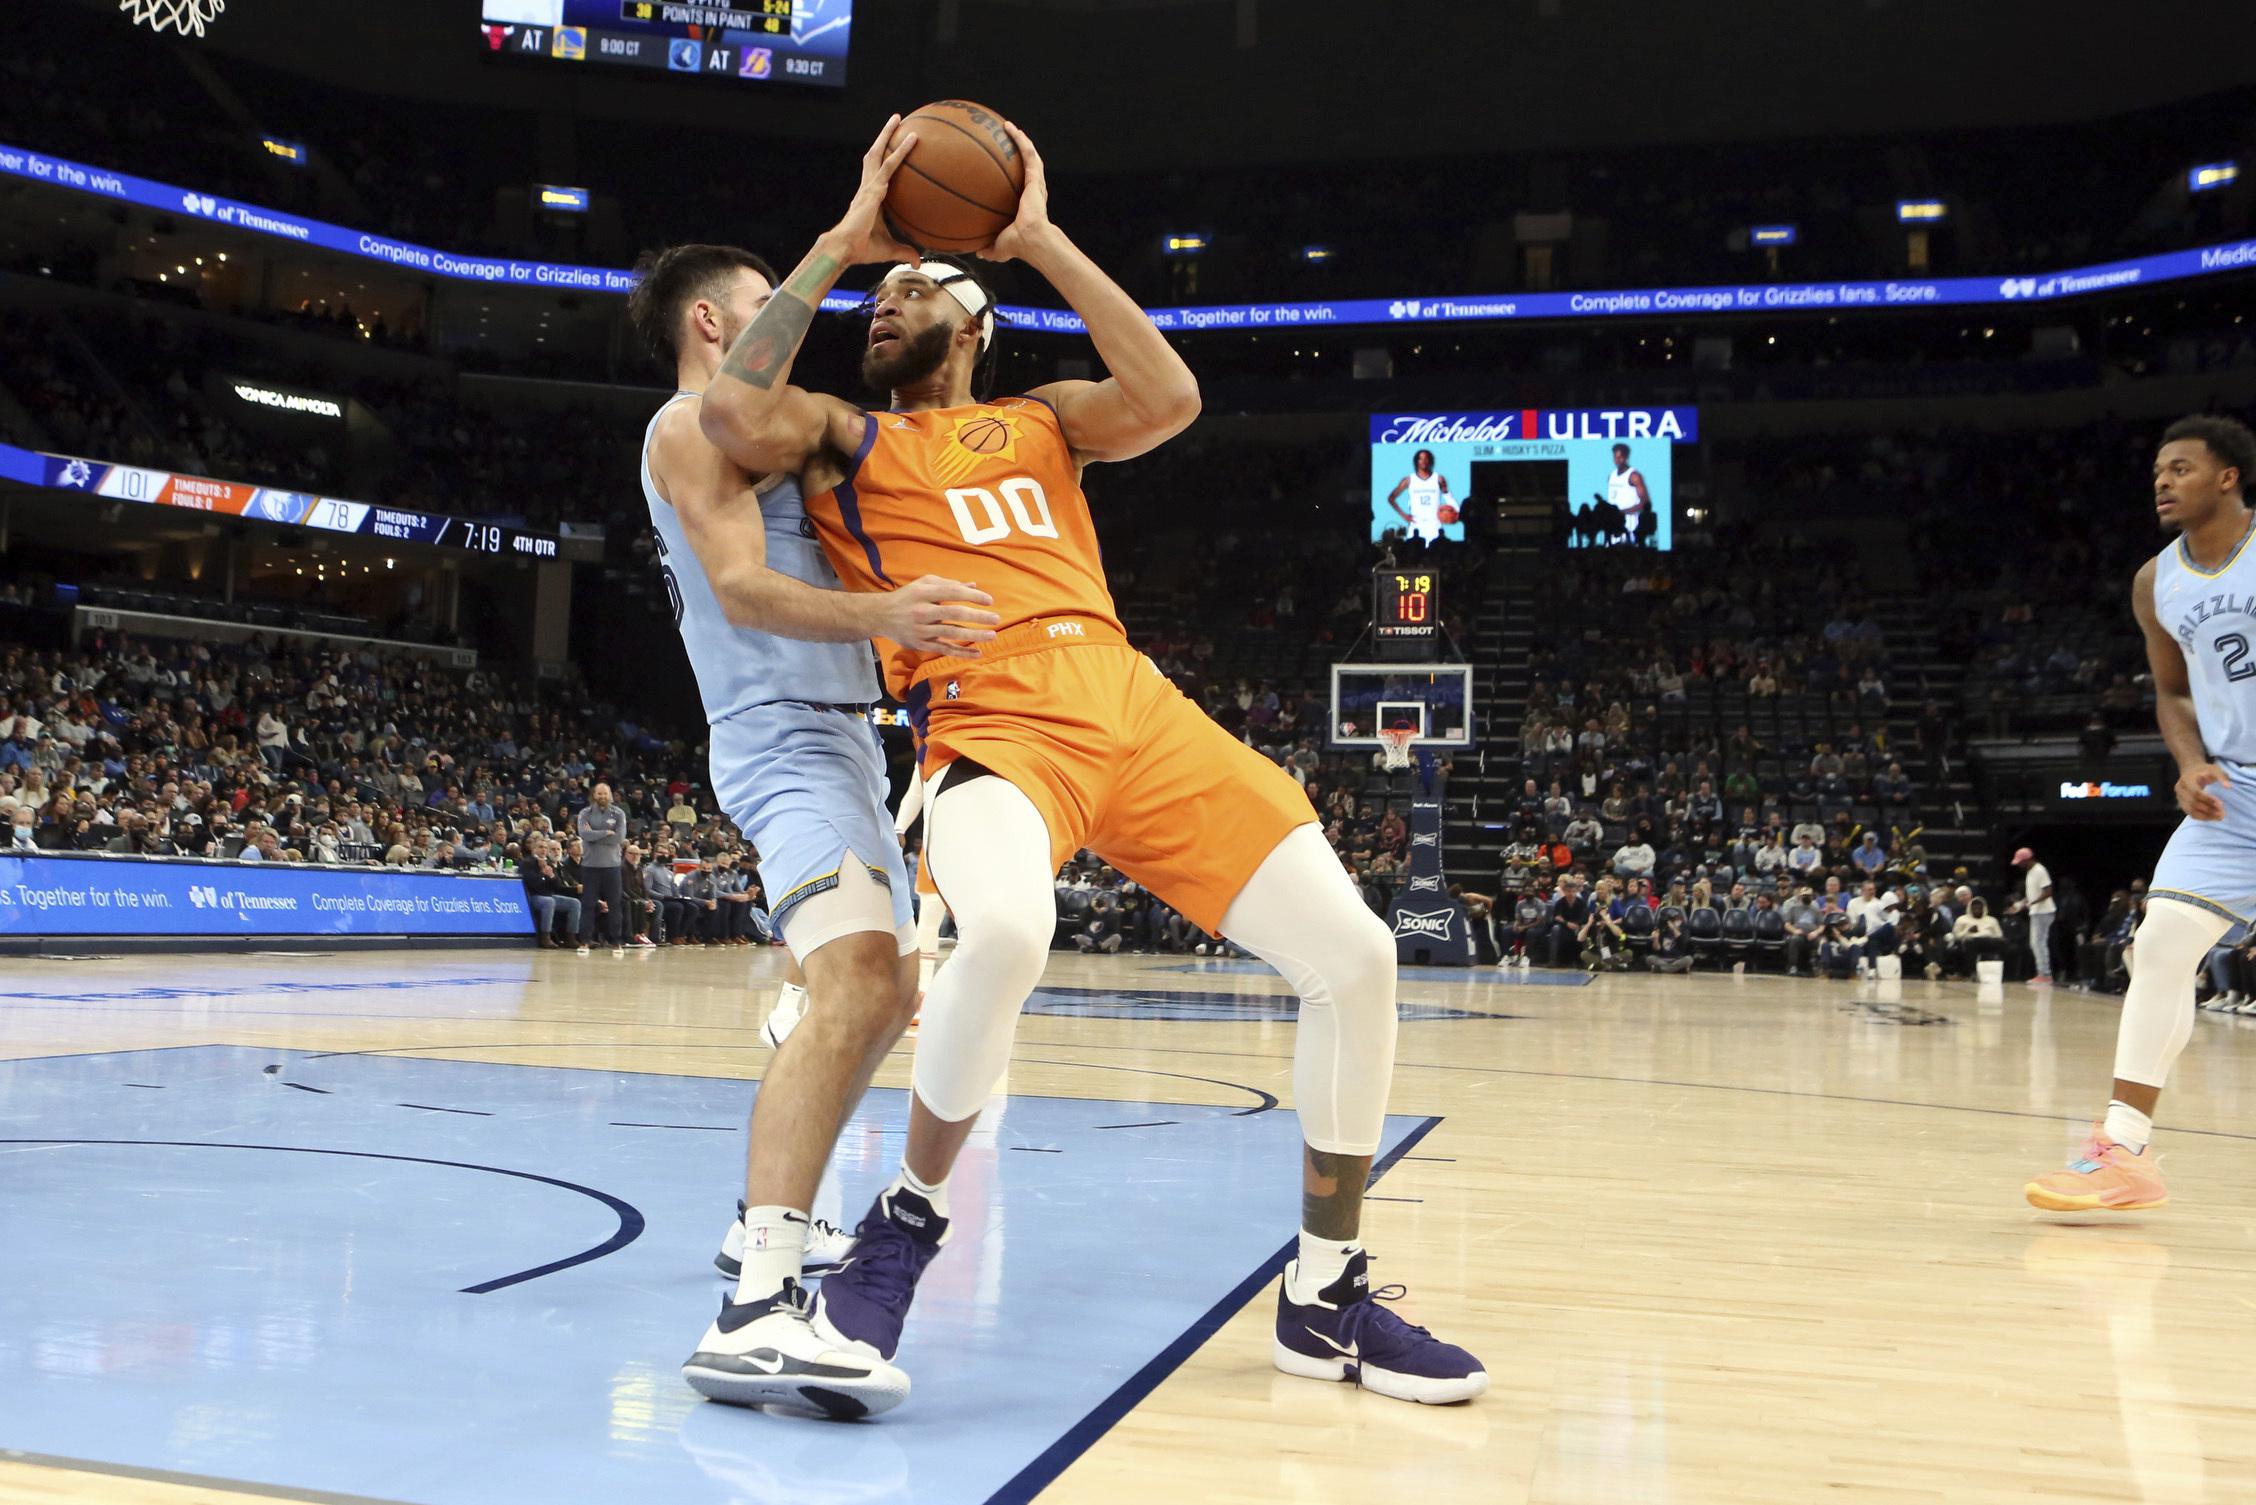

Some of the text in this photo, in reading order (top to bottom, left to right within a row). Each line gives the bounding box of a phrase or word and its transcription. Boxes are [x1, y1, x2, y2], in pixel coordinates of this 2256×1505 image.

[662, 5, 704, 24] POINTS
[705, 10, 718, 27] IN
[719, 12, 752, 30] PAINT
[521, 29, 543, 50] AT
[626, 41, 640, 56] CT
[709, 50, 730, 71] AT
[810, 60, 824, 75] CT
[28, 154, 54, 177] for
[57, 160, 86, 185] the
[90, 171, 126, 196] win.
[217, 206, 309, 239] of Tennessee
[359, 235, 429, 266] Complete
[433, 253, 505, 281] Coverage
[509, 263, 532, 280] for
[536, 265, 600, 287] Grizzlies
[2037, 267, 2141, 297] of Tennessee
[1423, 301, 1517, 318] of Tennessee
[1570, 283, 1940, 314] Complete Coverage for Grizzlies fans. Score.
[1180, 309, 1246, 328] Together
[1249, 307, 1271, 322] for
[1275, 306, 1300, 321] the
[1303, 305, 1337, 321] win.
[1381, 410, 1684, 444] Michelob ULTRA
[121, 471, 148, 499] 101
[173, 477, 231, 499] TIMEOUTS: 3
[171, 492, 205, 510] FOULS:
[944, 476, 1059, 545] 00
[327, 501, 349, 530] 78
[375, 508, 427, 529] TIMEOUTS: 2
[374, 522, 410, 540] FOULS: 2
[464, 522, 501, 553] 7:19
[513, 535, 534, 554] 4TH
[1395, 575, 1431, 593] 7:19
[1399, 592, 1426, 622] 10
[1046, 621, 1085, 638] PHX
[1393, 626, 1434, 635] TISSOT
[16, 884, 86, 911] Together
[89, 886, 111, 907] for
[114, 888, 138, 908] the
[141, 889, 173, 908] win.
[220, 890, 297, 911] of Tennessee
[312, 893, 522, 915] Complete Coverage for Grizzlies fans. Score.
[1401, 917, 1445, 931] SONIC
